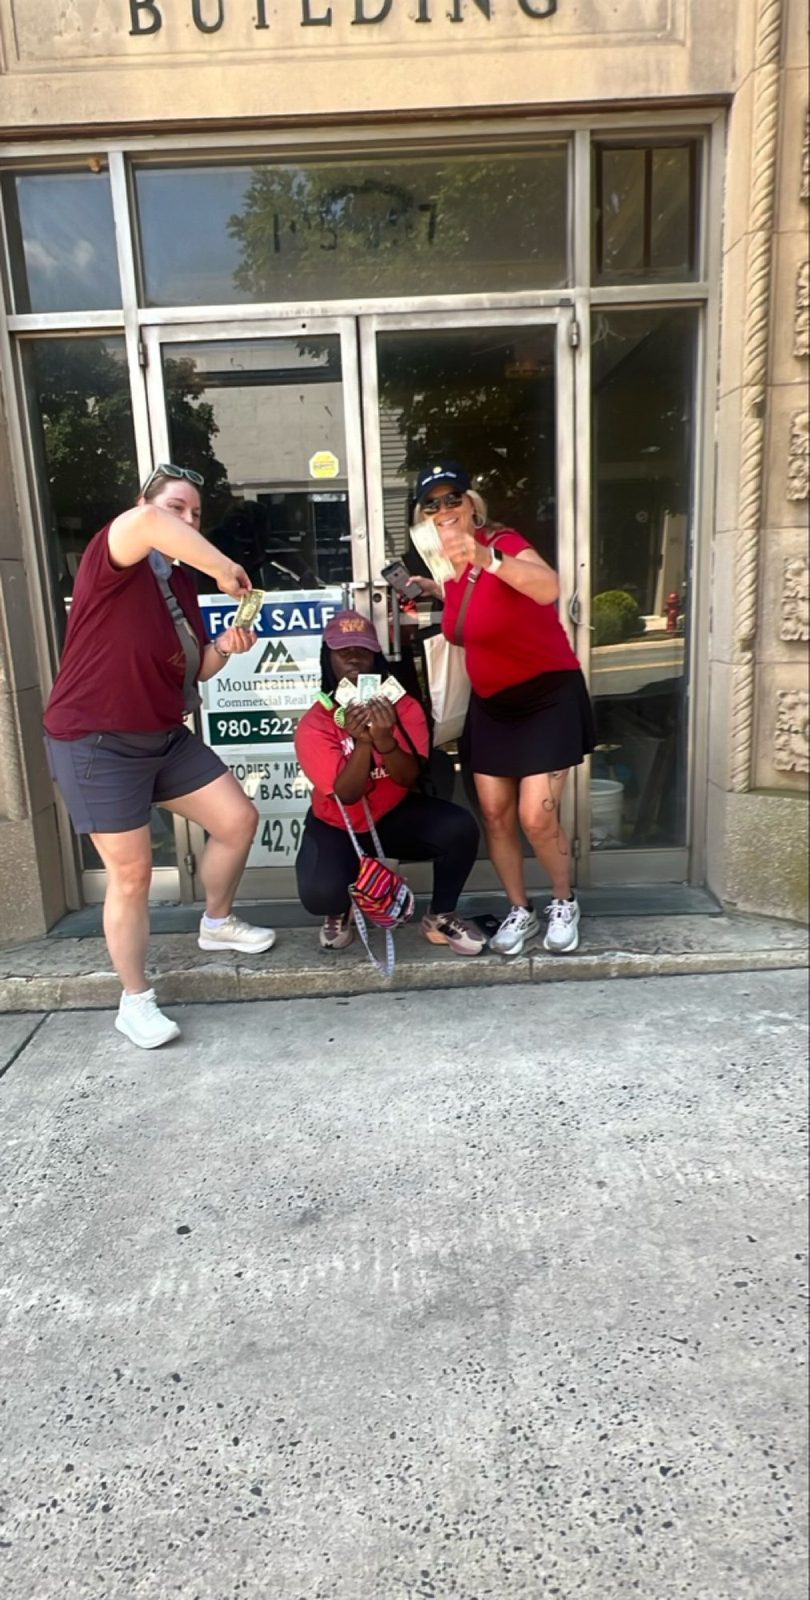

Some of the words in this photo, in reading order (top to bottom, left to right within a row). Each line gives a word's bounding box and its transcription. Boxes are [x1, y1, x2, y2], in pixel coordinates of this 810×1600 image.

[217, 675, 296, 692] Mountain
[217, 696, 281, 708] Commercial
[285, 694, 310, 705] Real
[217, 717, 298, 737] 980-522-
[229, 763, 271, 780] TORIES
[261, 783, 312, 800] BASE
[261, 819, 306, 856] 42,9
